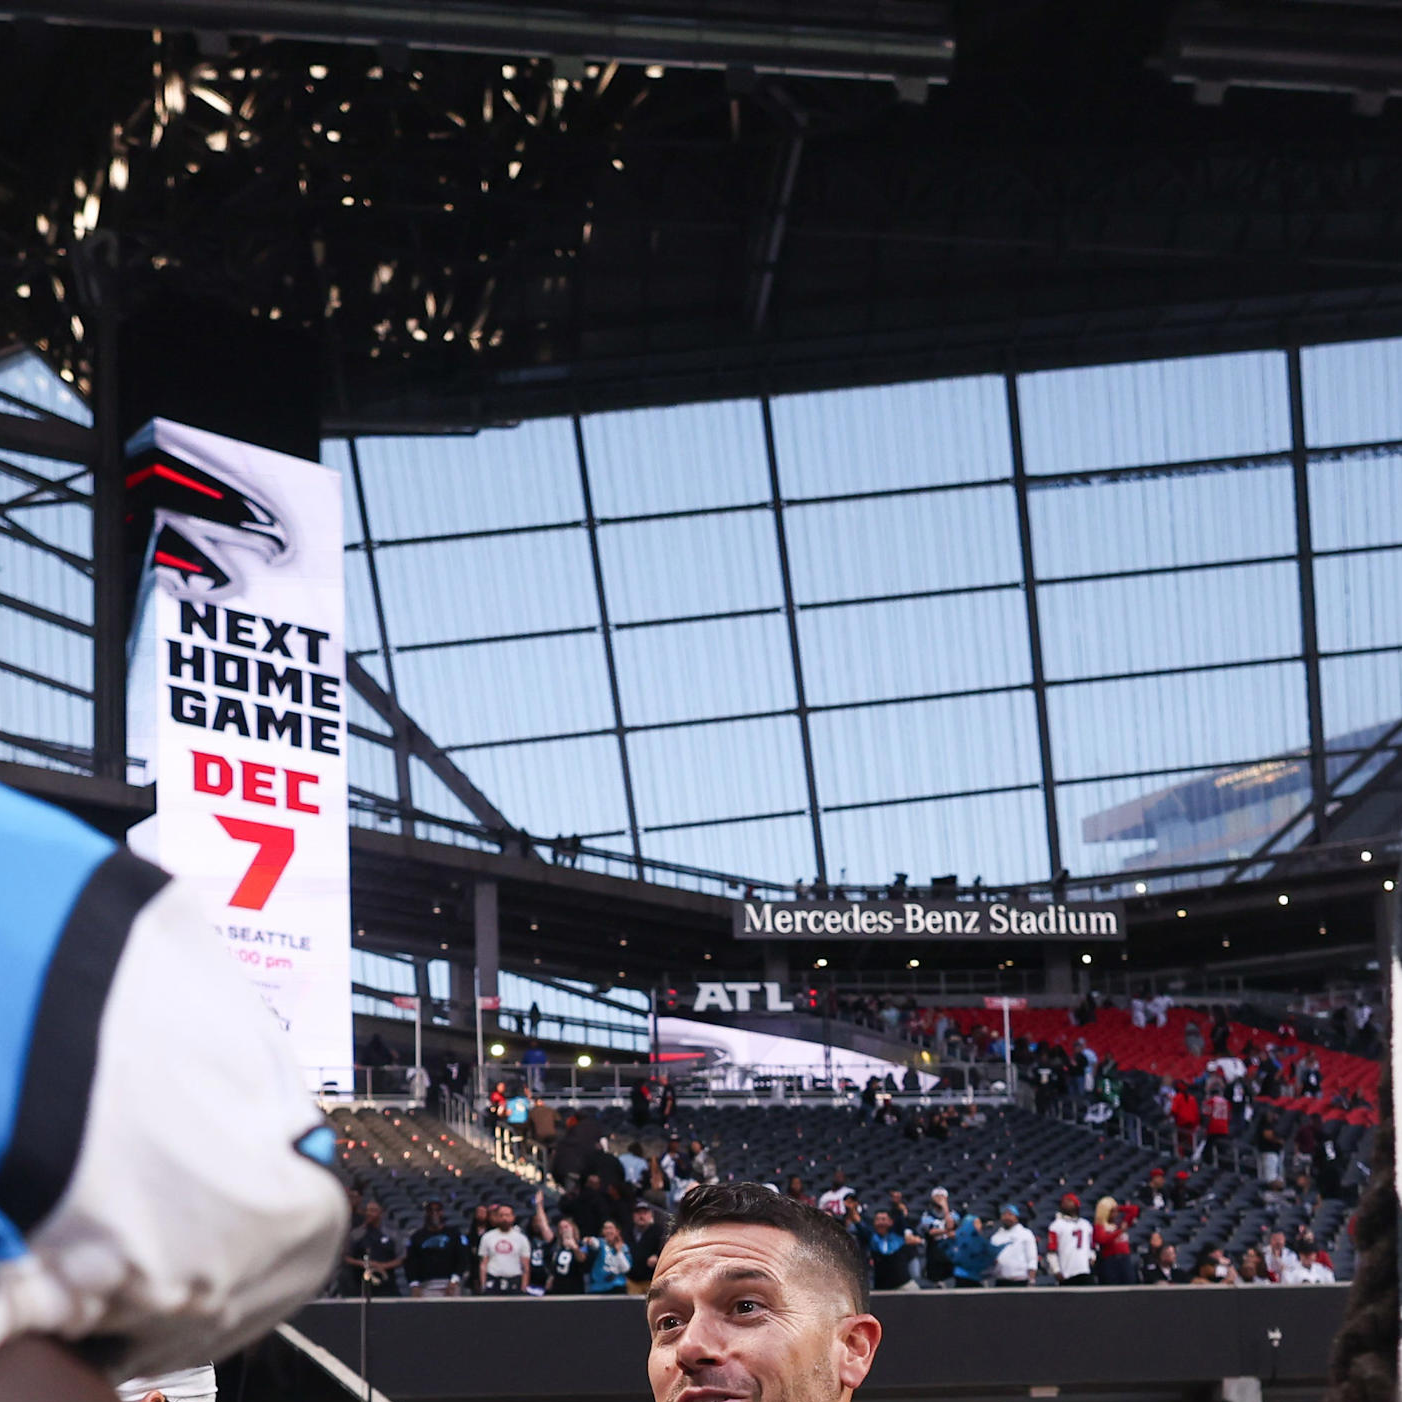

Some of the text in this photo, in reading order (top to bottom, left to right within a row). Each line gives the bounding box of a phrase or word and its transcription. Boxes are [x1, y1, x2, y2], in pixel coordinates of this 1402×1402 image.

[179, 600, 330, 665] NEXT
[167, 640, 341, 714] HOME
[167, 685, 341, 756] GAME
[191, 750, 321, 815] DEC
[213, 813, 295, 912] 7
[227, 925, 311, 952] SEATTLE
[742, 903, 1119, 936] Mercedes-Benz Stadium
[693, 982, 794, 1012] ATL
[557, 1250, 573, 1276] 9
